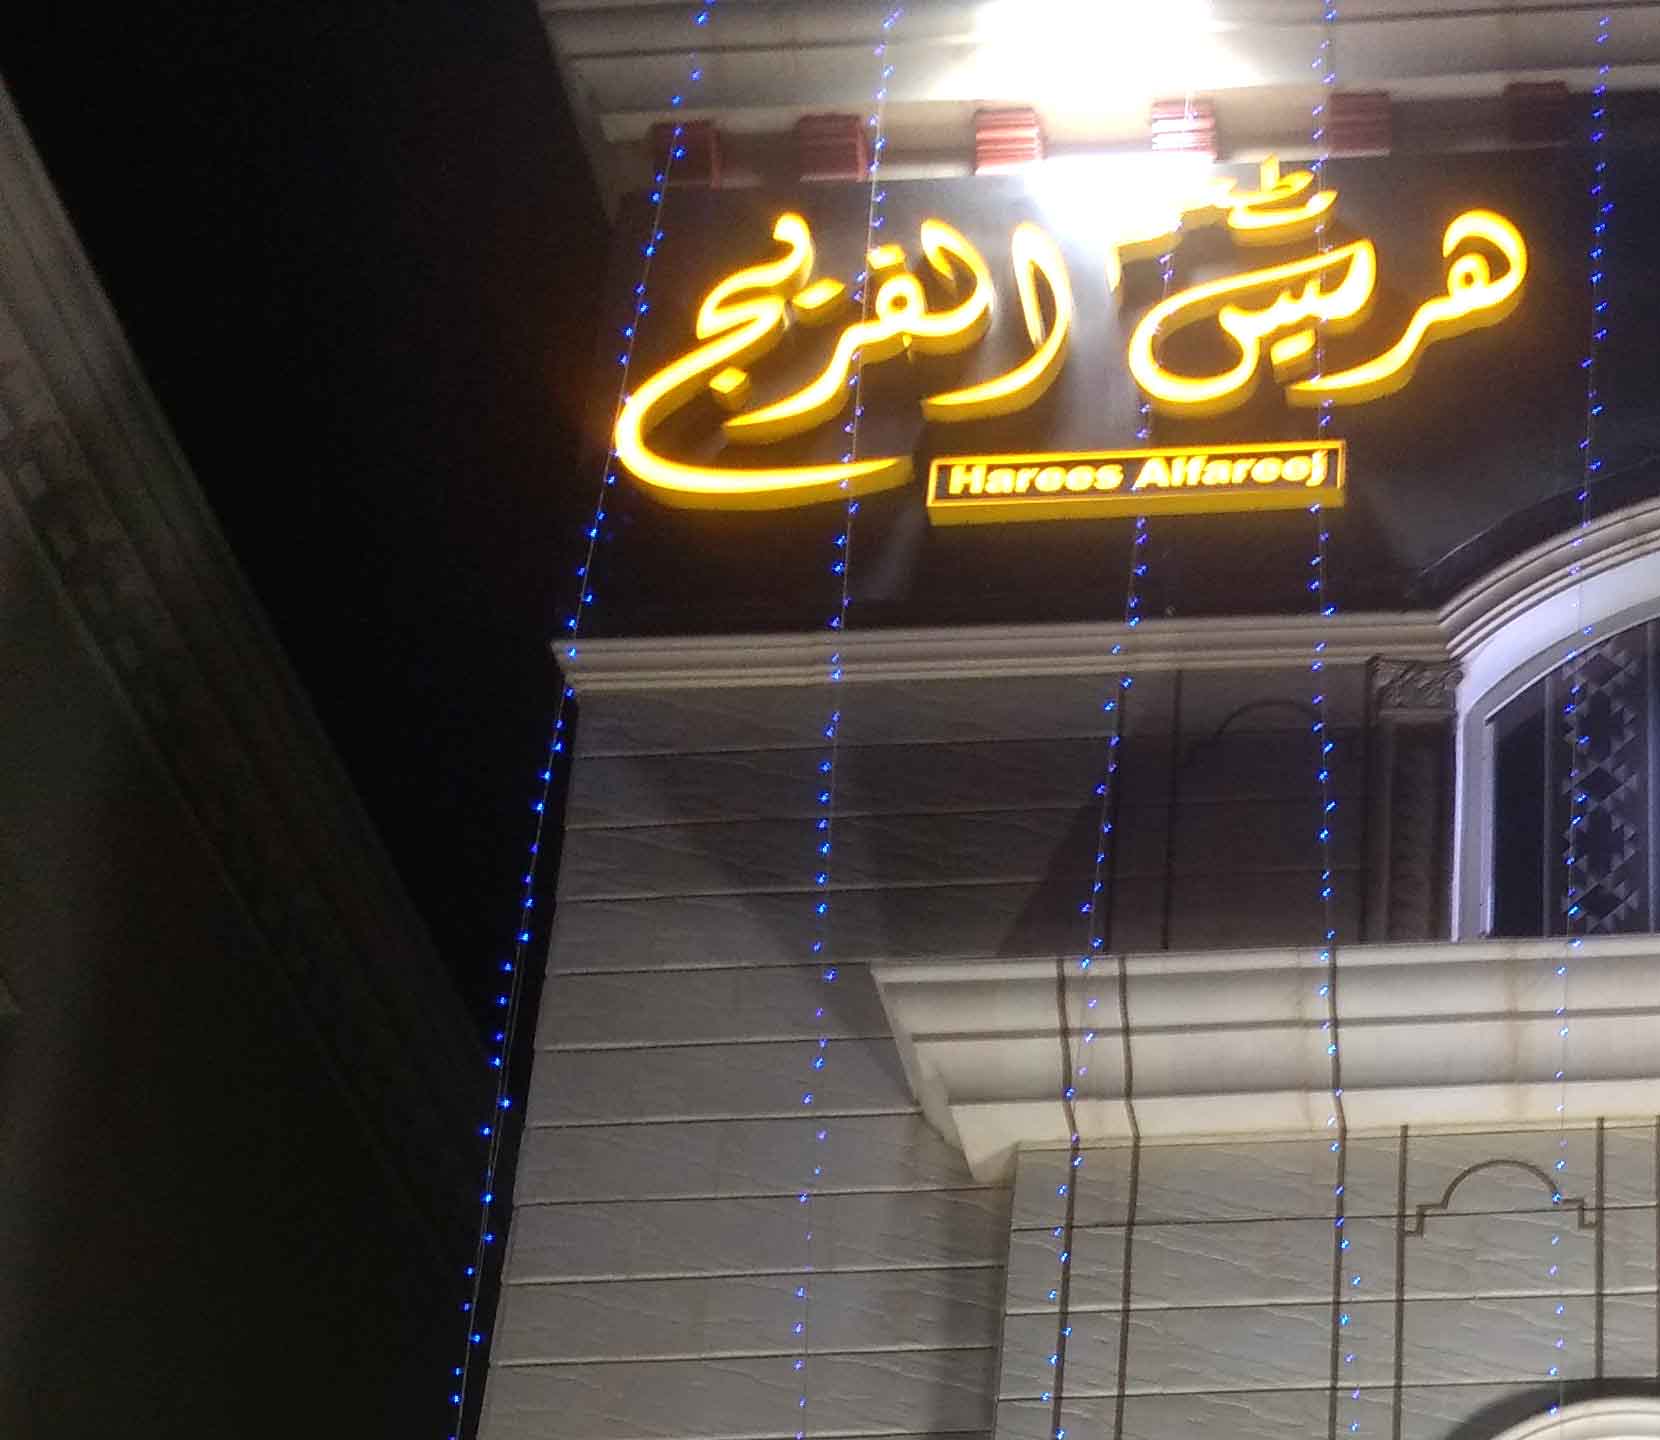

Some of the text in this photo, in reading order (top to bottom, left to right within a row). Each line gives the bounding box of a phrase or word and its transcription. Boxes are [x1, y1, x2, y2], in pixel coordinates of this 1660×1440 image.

[613, 207, 1528, 503] هريس الفريج
[949, 449, 1329, 495] Harees Alfareej
